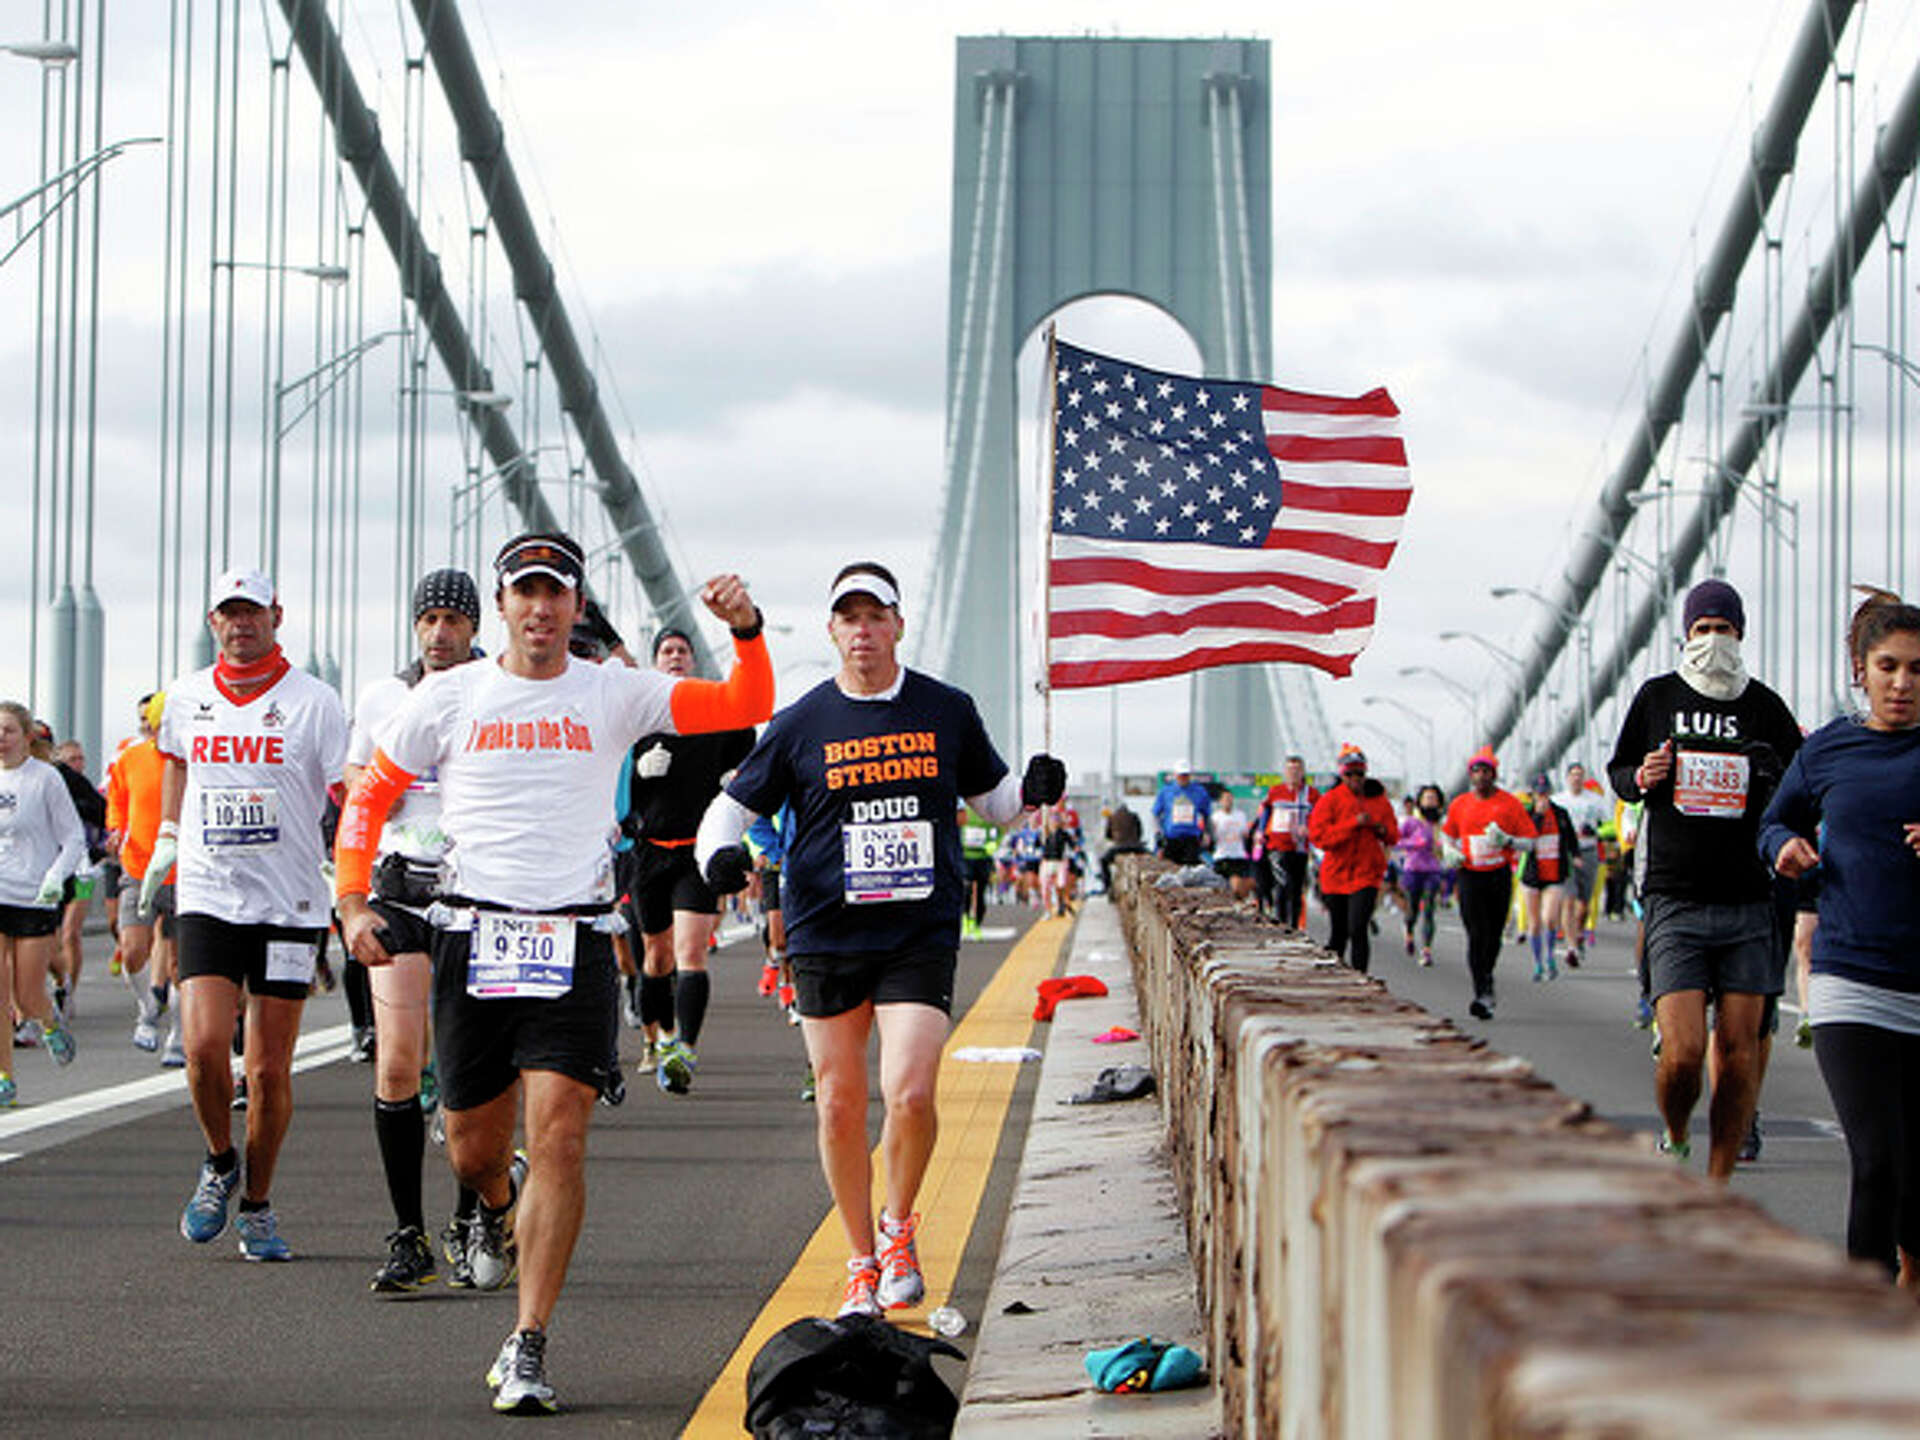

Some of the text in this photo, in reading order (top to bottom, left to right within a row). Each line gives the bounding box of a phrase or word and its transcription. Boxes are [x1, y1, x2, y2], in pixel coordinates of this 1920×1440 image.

[475, 716, 514, 752] wake
[516, 721, 535, 753] up
[538, 716, 562, 750] the
[563, 716, 594, 752] Sun
[824, 732, 937, 764] BOSTON
[191, 735, 284, 765] REWE
[825, 756, 939, 790] STRONG
[216, 804, 265, 826] 10-111
[851, 795, 919, 823] DOUG
[863, 841, 919, 868] 9-504
